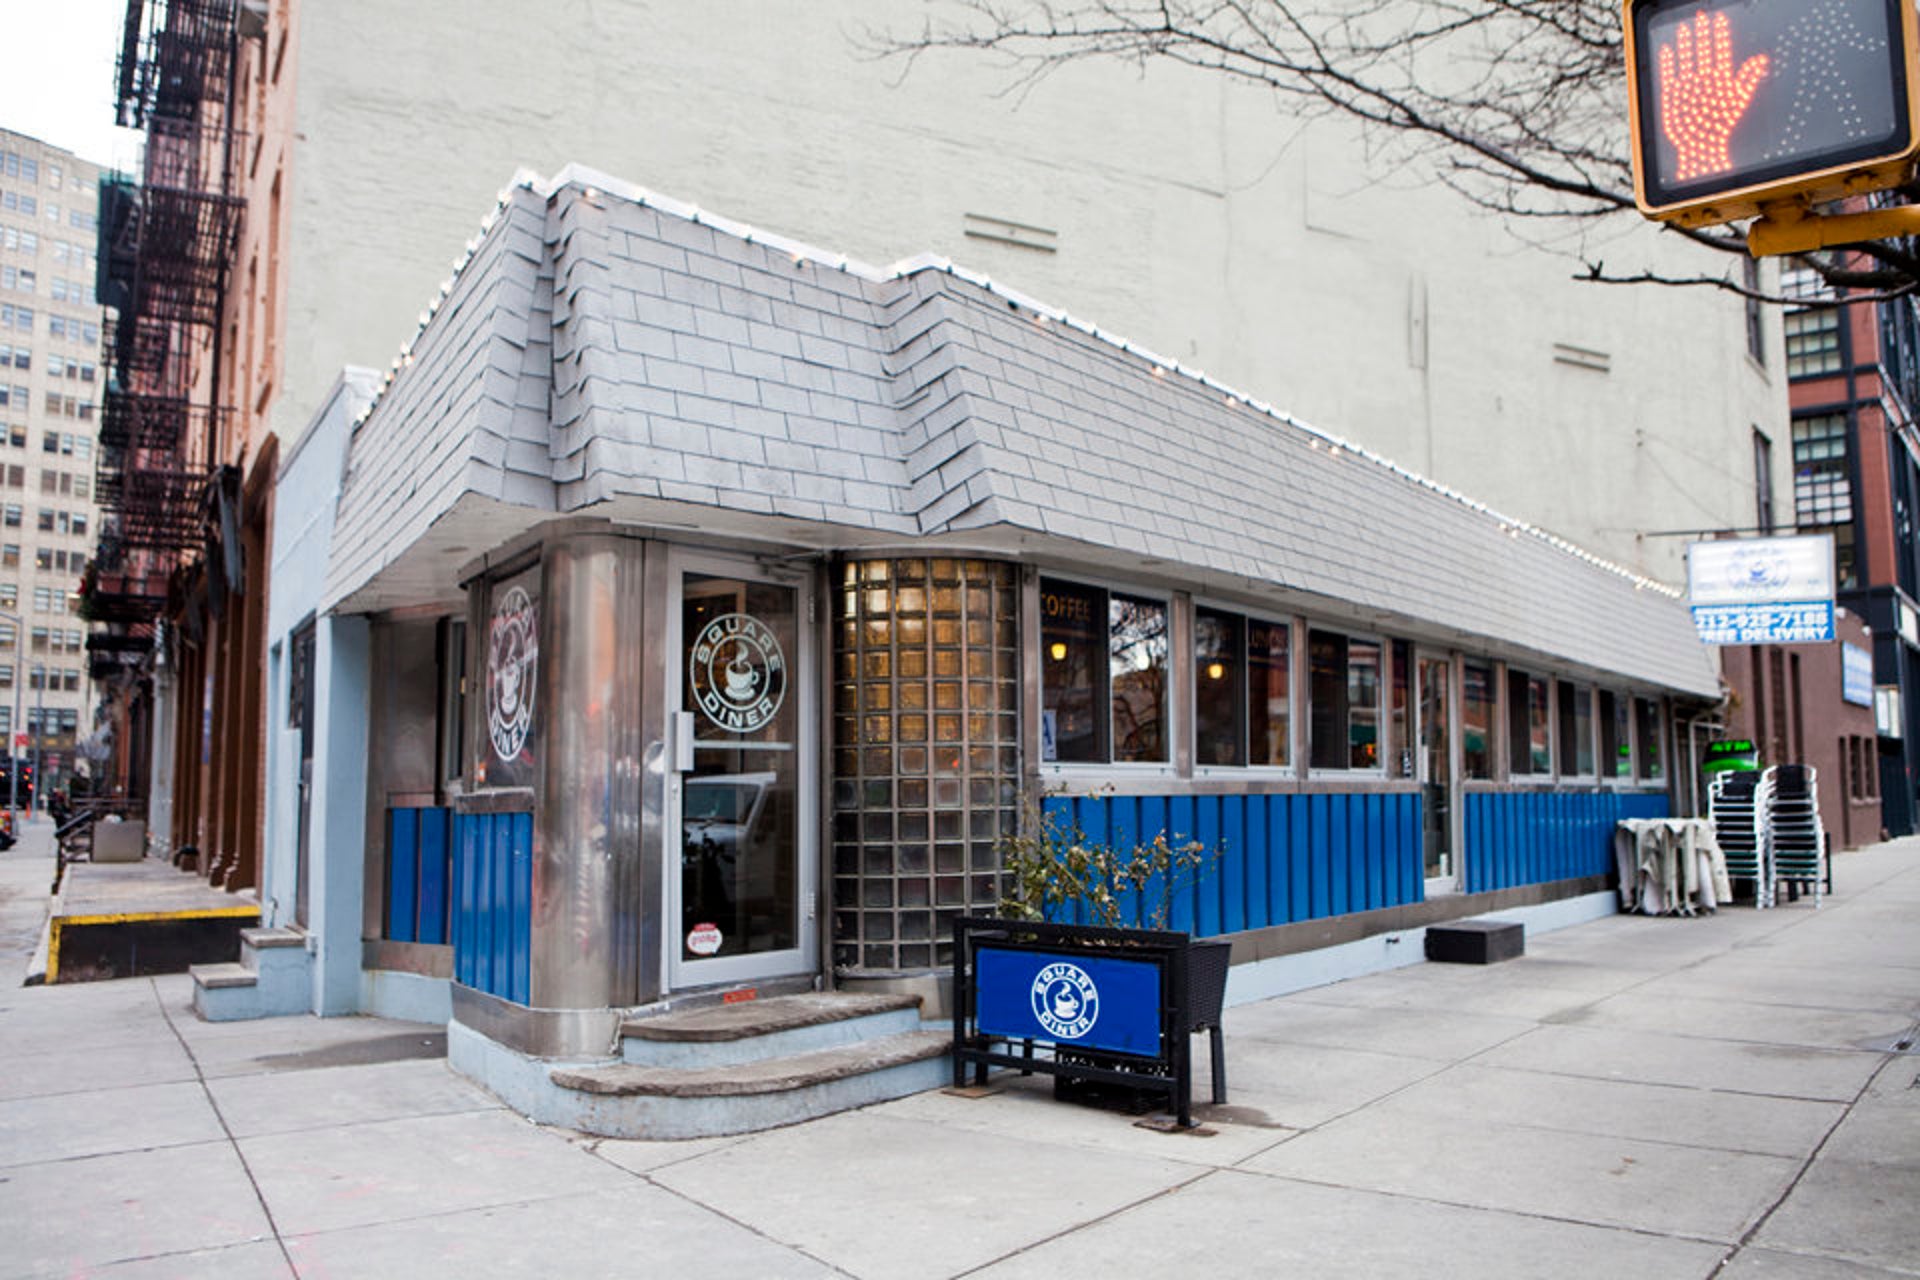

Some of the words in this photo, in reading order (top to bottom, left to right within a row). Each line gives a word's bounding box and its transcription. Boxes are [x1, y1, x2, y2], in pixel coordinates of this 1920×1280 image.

[1041, 592, 1089, 621] COFFEE
[697, 618, 780, 671] SQUARE
[1742, 626, 1827, 641] DELIVERY
[704, 692, 773, 727] DINER
[1711, 739, 1750, 752] ATM
[1034, 966, 1095, 1000] SQUARE
[1041, 1011, 1089, 1035] DINER
